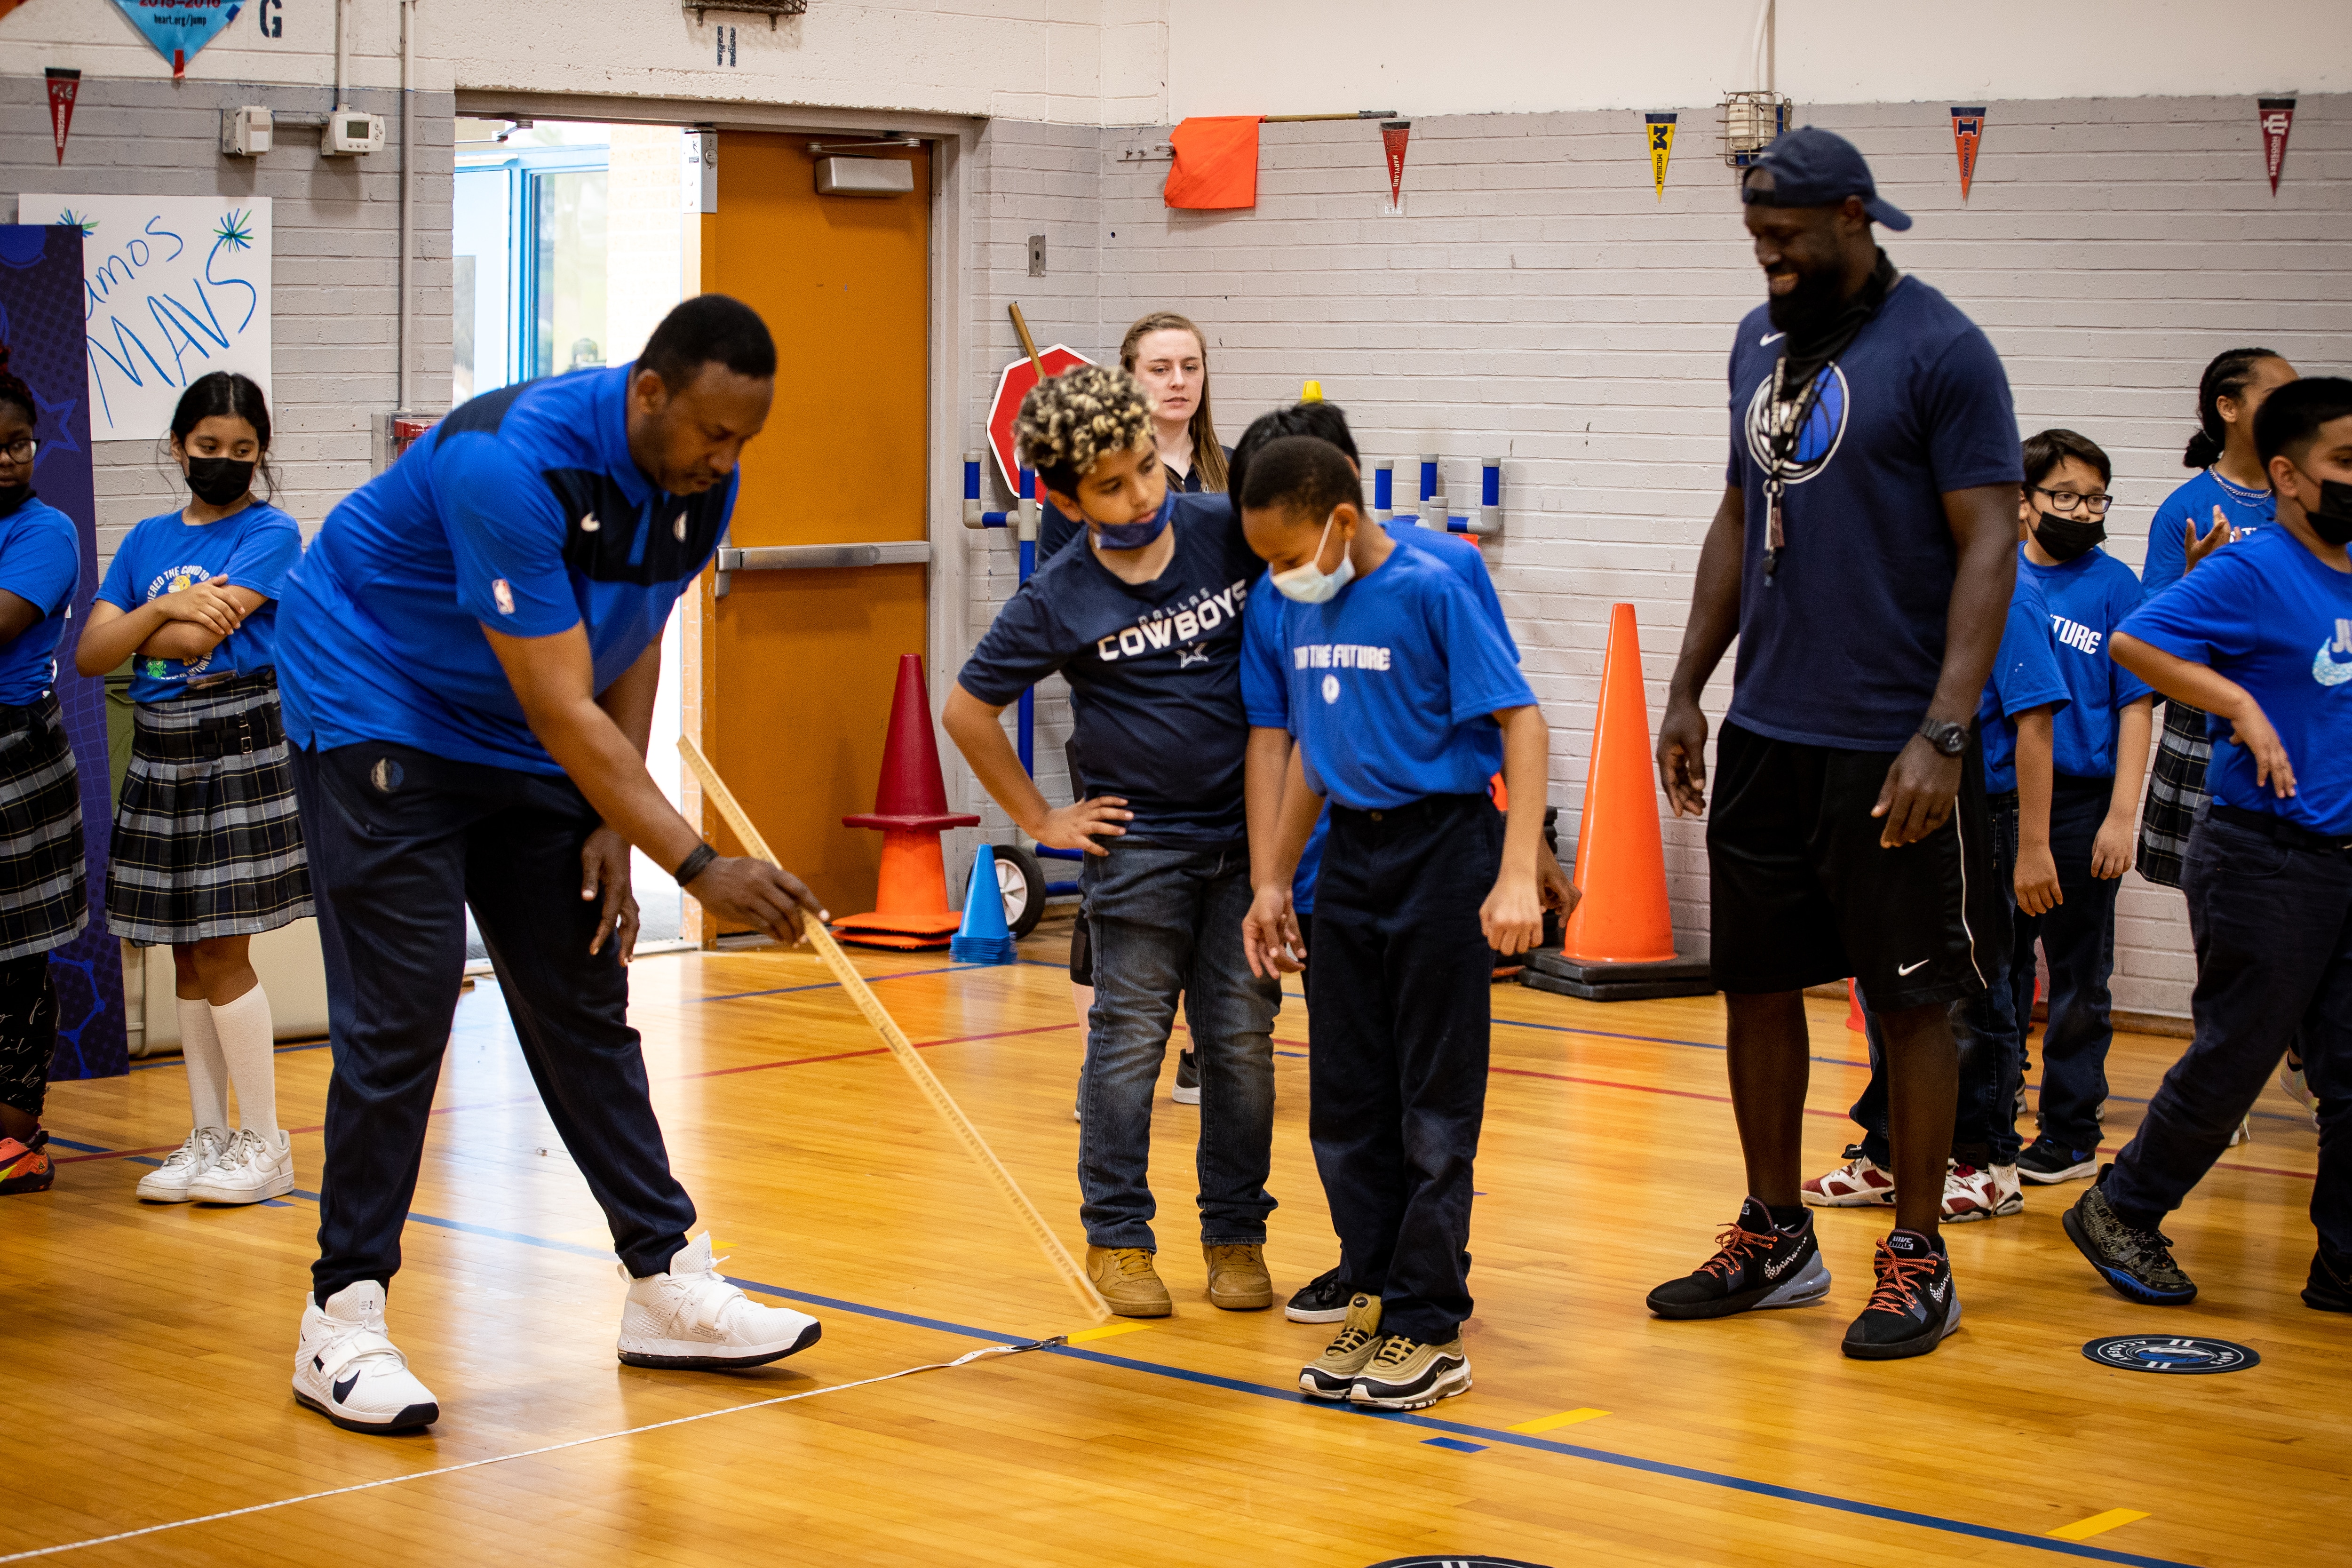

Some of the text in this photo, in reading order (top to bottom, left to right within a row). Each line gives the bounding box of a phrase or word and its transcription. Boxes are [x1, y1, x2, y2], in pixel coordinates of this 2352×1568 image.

[154, 14, 207, 27] heart.org/jump
[259, 0, 282, 38] G
[717, 25, 736, 66] H
[57, 103, 65, 148] WISCONSIN
[1653, 126, 1668, 150] M
[87, 234, 256, 429] MAVS
[163, 566, 180, 580] THE
[1097, 579, 1248, 661] COWBOYS
[1137, 587, 1210, 625] DALLAS
[2050, 614, 2102, 654] TURE
[1308, 644, 1333, 669] THE
[1332, 644, 1391, 671] FUTURE
[2107, 1340, 2146, 1361] ACADEMY
[2209, 1352, 2234, 1365] MAVS
